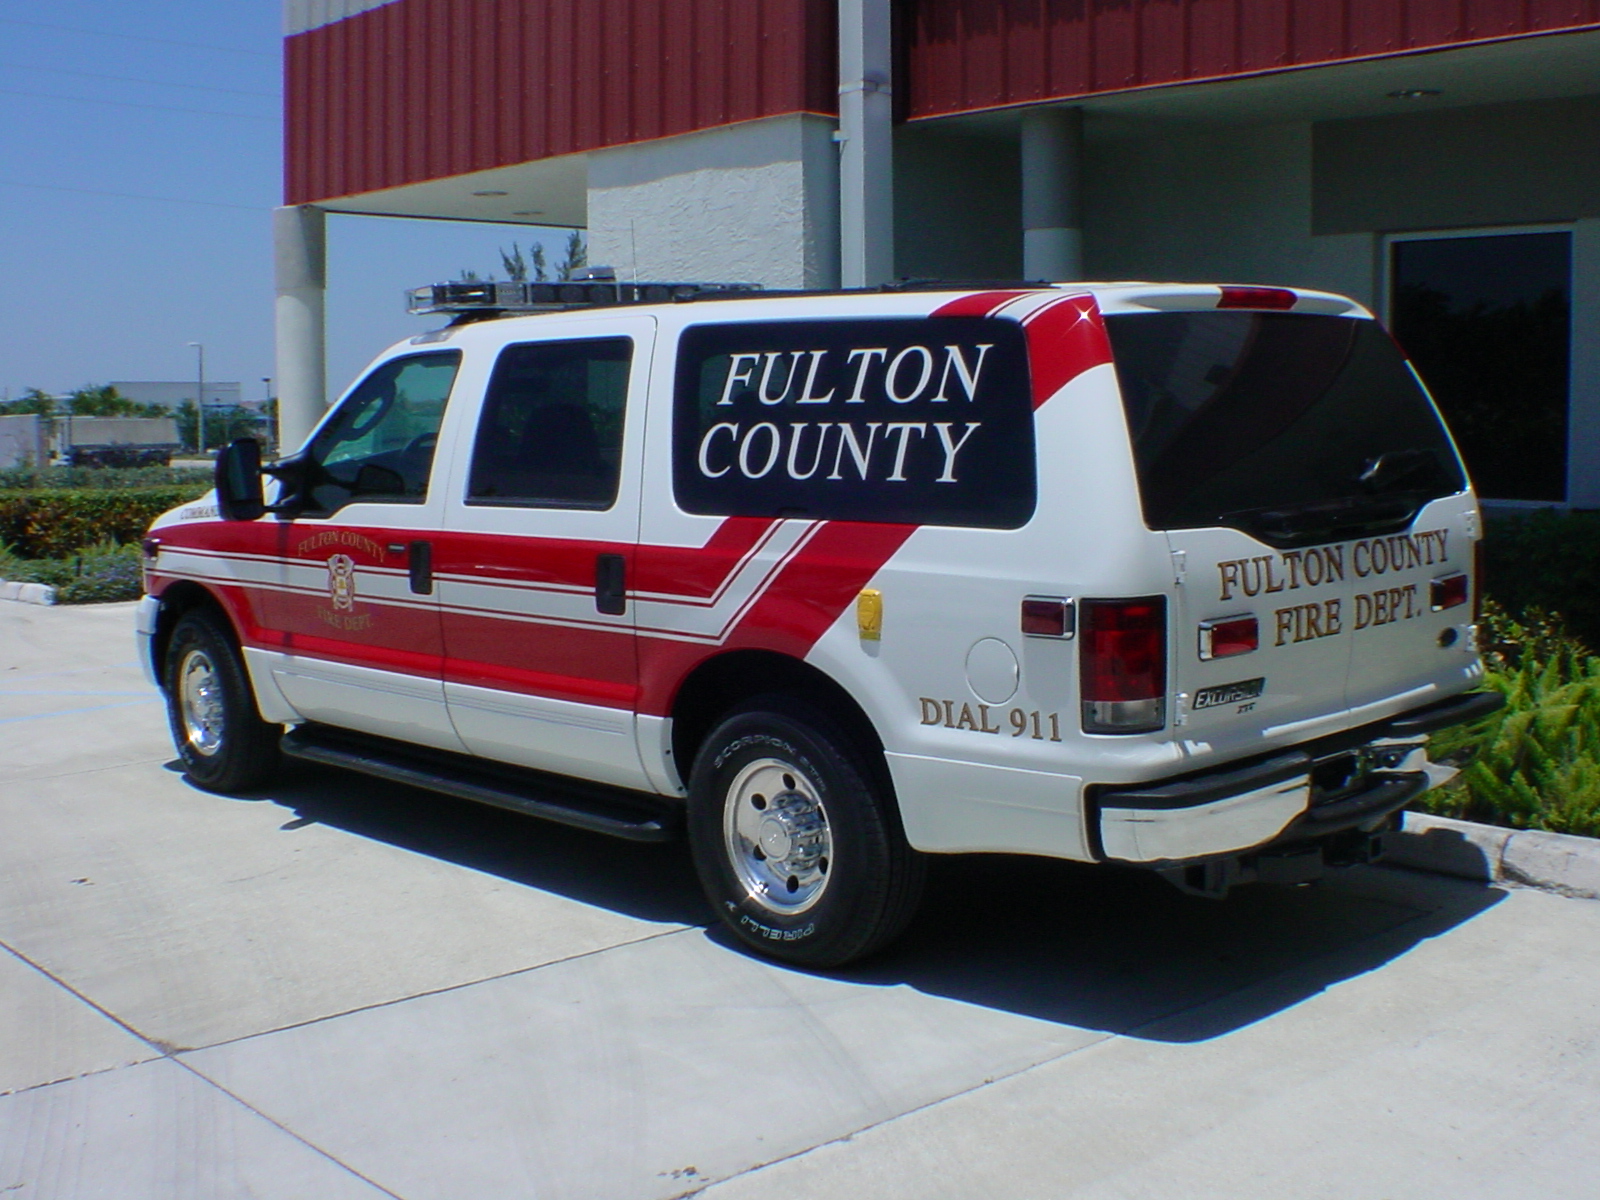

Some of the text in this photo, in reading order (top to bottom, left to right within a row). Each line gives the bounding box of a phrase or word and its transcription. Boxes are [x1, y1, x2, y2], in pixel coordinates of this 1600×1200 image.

[716, 344, 994, 406] FULTON
[698, 422, 982, 483] COUNTY
[298, 530, 386, 563] FULTON COUNTY
[1218, 528, 1448, 600] FULTON COUNTY
[1274, 584, 1422, 646] FIRE DEPT.
[919, 697, 1062, 742] DIAL 911
[740, 915, 815, 941] PIRELLI
